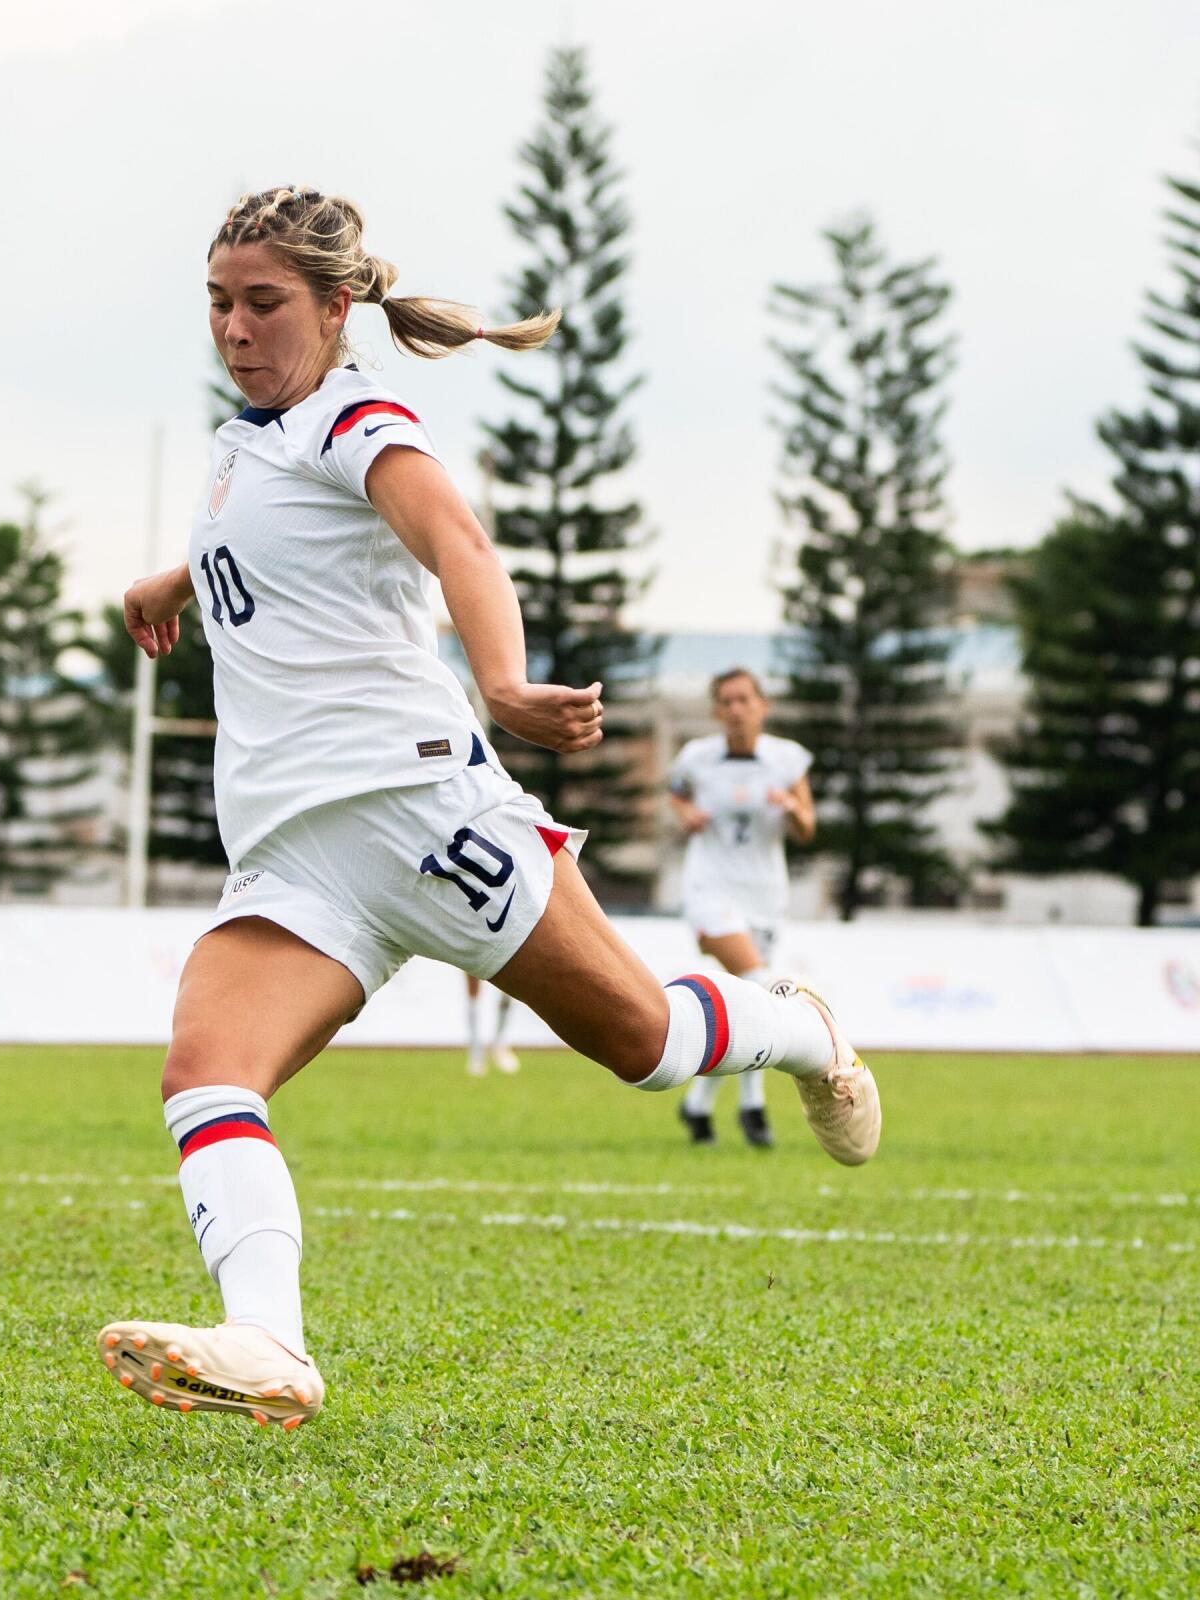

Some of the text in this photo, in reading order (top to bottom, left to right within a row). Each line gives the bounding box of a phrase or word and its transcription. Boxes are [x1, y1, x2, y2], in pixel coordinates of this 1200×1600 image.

[201, 545, 255, 629] 10
[420, 827, 514, 912] 10
[191, 1202, 207, 1229] SA
